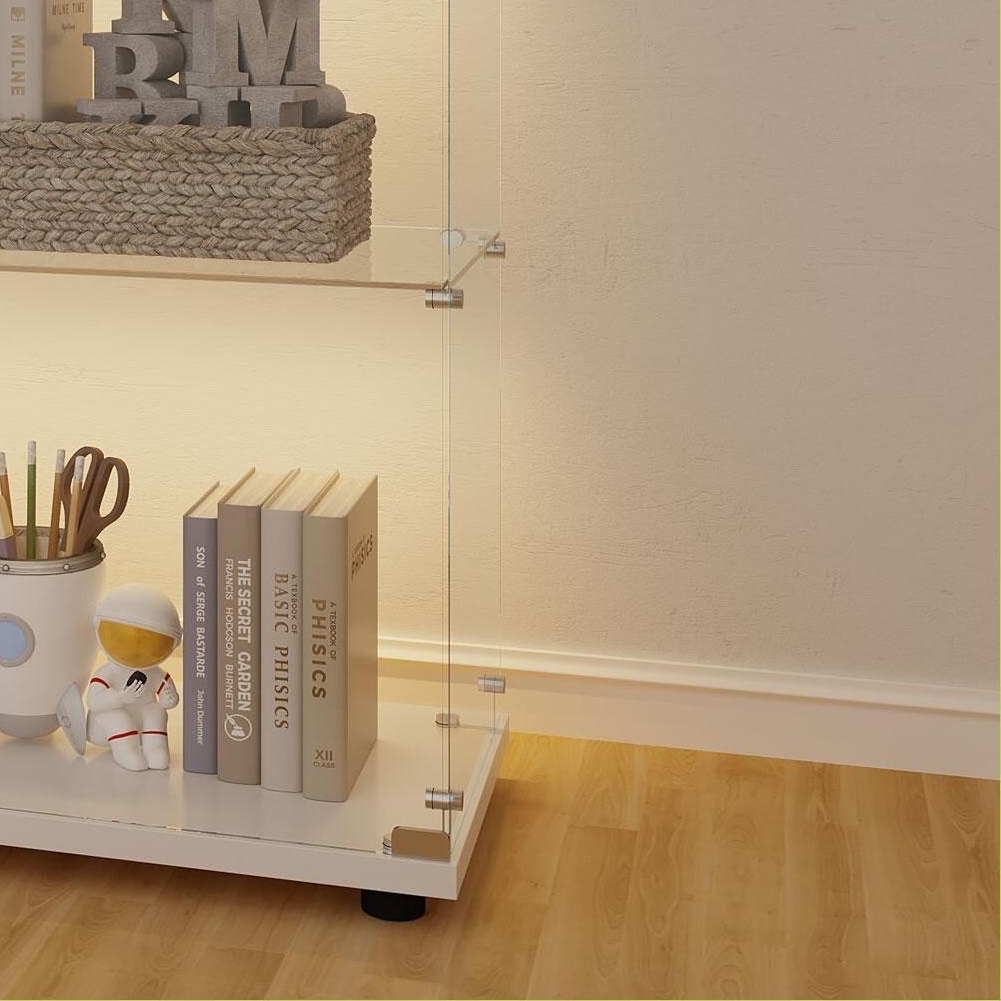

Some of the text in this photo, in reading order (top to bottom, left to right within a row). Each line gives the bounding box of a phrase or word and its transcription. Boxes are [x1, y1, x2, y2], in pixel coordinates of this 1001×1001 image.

[11, 35, 25, 96] MILNE
[196, 546, 206, 568] SON
[196, 576, 206, 586] of
[196, 591, 206, 622] SERGE
[196, 627, 206, 678] BASTARDE
[225, 558, 234, 710] FRANCIS HODGSON BURNETT
[237, 558, 251, 711] THE SECRET GARDEN
[274, 573, 289, 729] BASIC PHISICS
[311, 599, 327, 699] PHISICS
[329, 650, 337, 660] OF
[197, 689, 205, 709] John
[314, 750, 333, 761] XII
